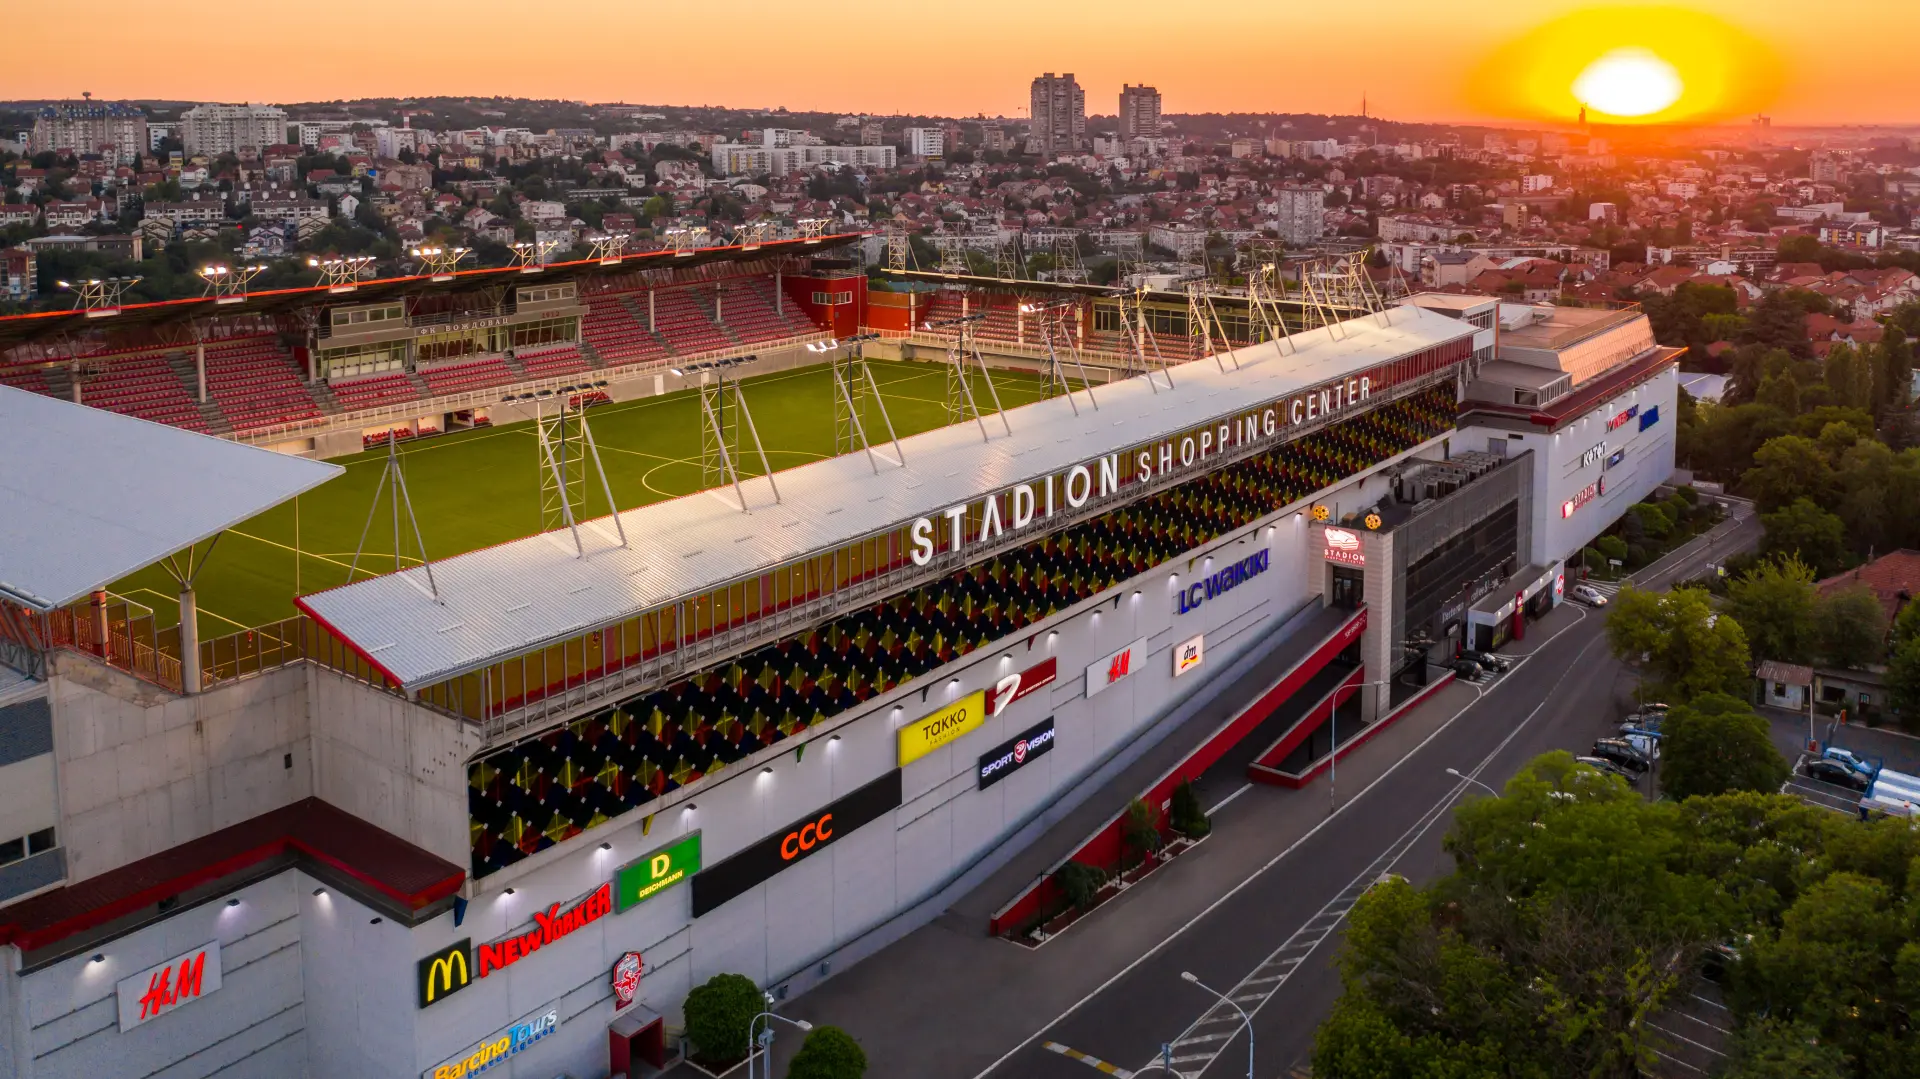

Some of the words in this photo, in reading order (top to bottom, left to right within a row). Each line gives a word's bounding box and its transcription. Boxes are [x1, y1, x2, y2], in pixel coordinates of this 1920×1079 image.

[420, 327, 436, 335] ФК
[445, 317, 509, 332] ВОЖДОВАЦ
[909, 453, 1118, 566] STADION
[1137, 409, 1275, 483] SHOPPING
[1290, 376, 1370, 425] CENTER
[1324, 548, 1365, 562] STADION
[1178, 582, 1203, 615] LC
[1108, 648, 1131, 683] H&M
[1184, 645, 1197, 660] dm
[929, 726, 960, 746] FASHION
[981, 751, 1014, 777] SPORT
[1026, 727, 1055, 751] VISION
[780, 813, 833, 861] CCC
[651, 854, 670, 879] D
[639, 869, 683, 898] DEICHMANN
[139, 951, 206, 1020] H&M
